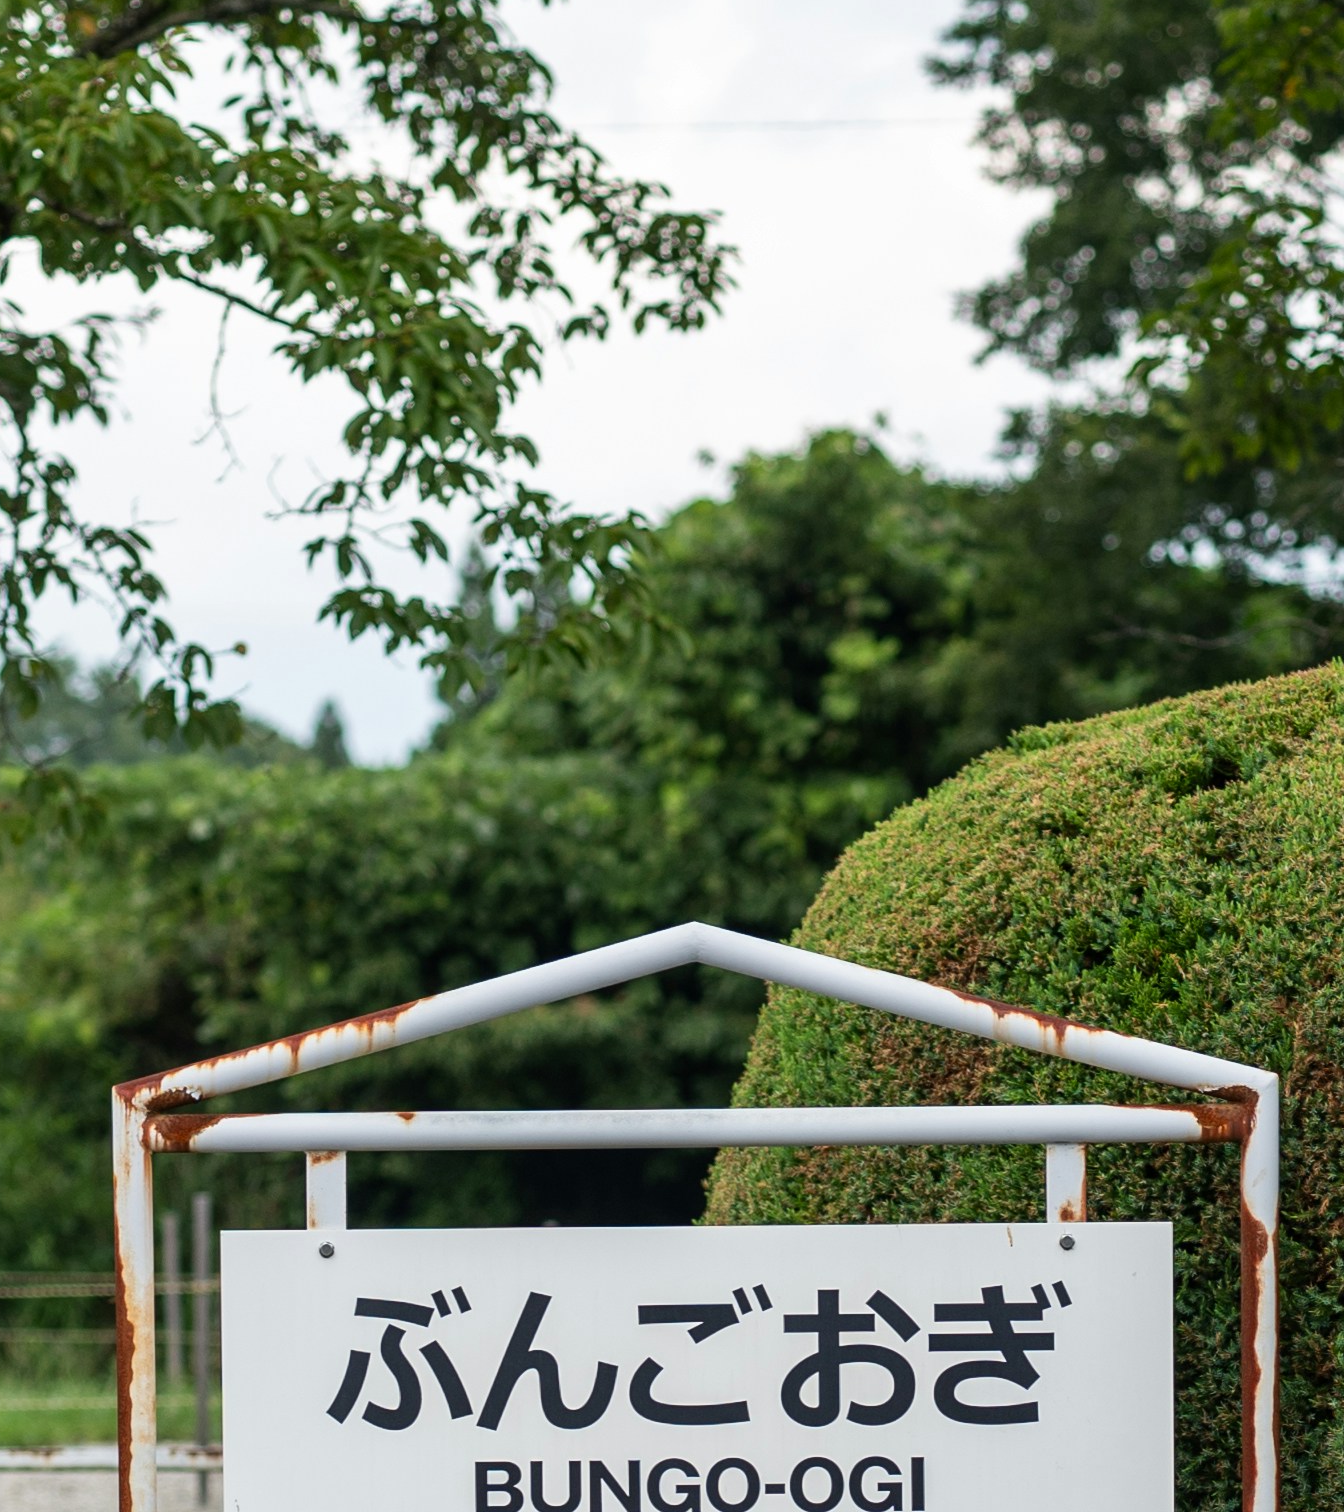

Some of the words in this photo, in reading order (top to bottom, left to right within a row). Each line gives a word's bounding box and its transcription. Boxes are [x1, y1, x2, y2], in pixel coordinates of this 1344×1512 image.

[326, 1280, 1073, 1432] ぶんごおぎ
